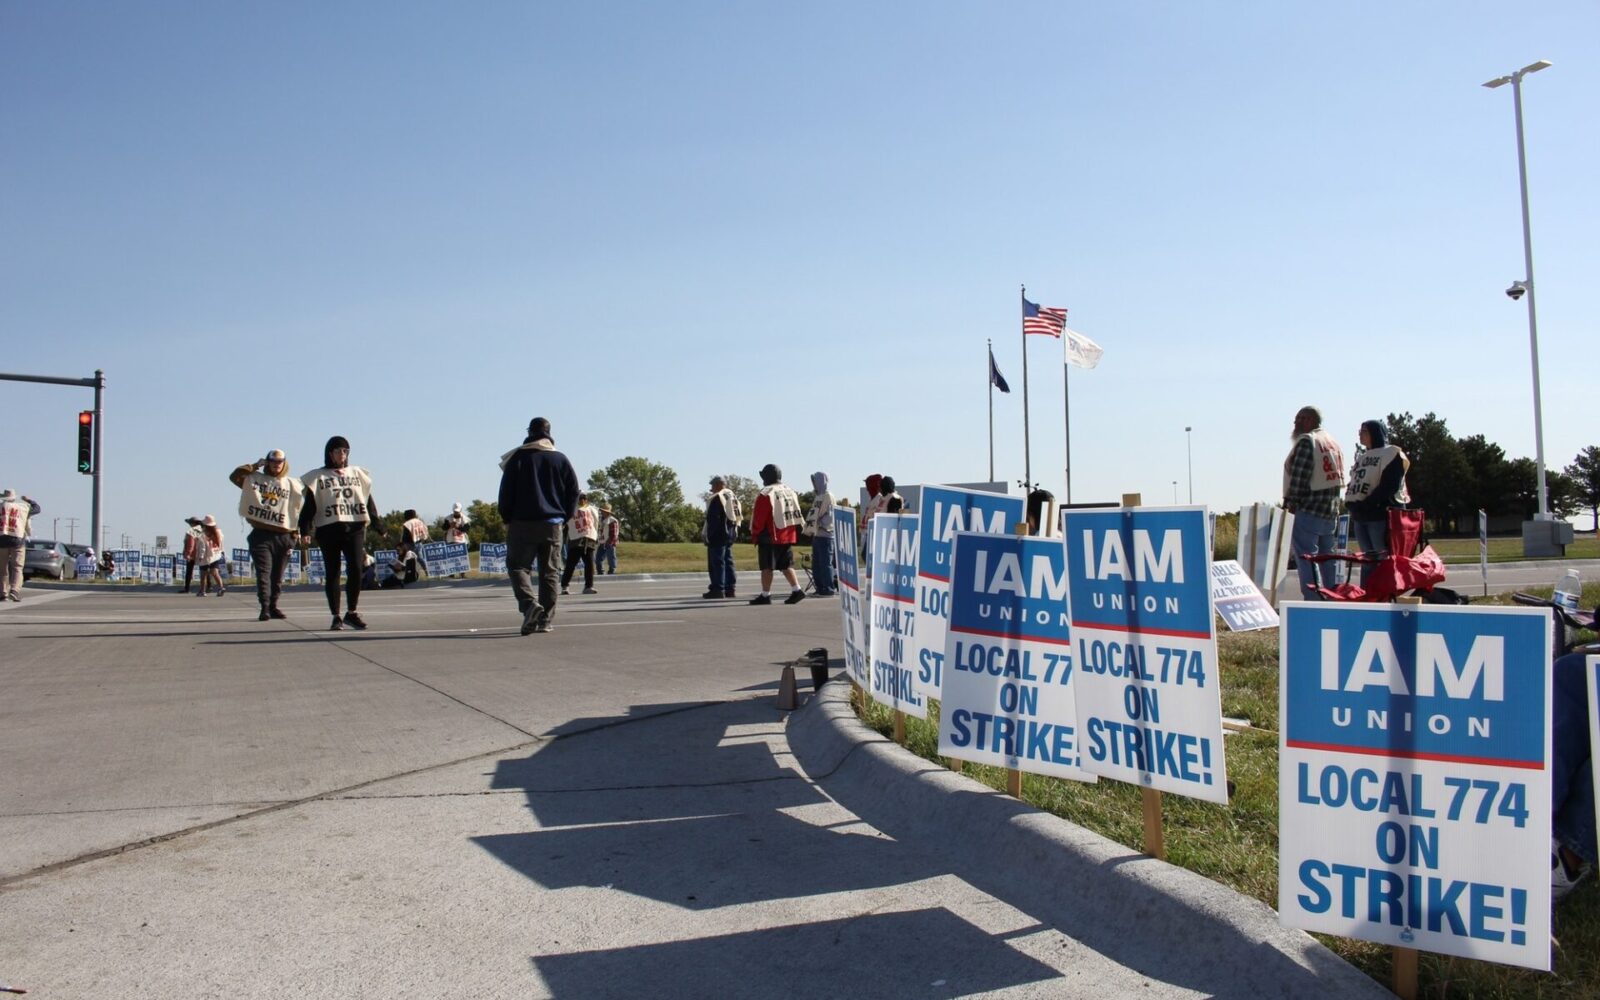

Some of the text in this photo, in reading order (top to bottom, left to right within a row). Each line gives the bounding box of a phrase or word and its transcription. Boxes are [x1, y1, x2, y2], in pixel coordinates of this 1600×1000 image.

[325, 503, 366, 517] STRIKE
[333, 488, 353, 499] 70
[248, 505, 285, 523] STRIKE
[933, 501, 1006, 543] IAM
[447, 545, 464, 553] IAM
[881, 528, 919, 567] IAM
[1083, 529, 1184, 584] IAM
[882, 572, 916, 588] UNION
[973, 550, 1067, 601] IAM
[1217, 576, 1233, 587] ON
[921, 586, 949, 619] LOC
[979, 603, 1071, 627] UNION
[1093, 592, 1179, 614] UNION
[1230, 608, 1272, 626] IAM
[875, 604, 915, 637] LOCAL 77
[890, 637, 903, 663] ON
[954, 641, 1037, 681] LOCAL
[1043, 653, 1072, 686] 77
[1079, 638, 1205, 688] LOCAL 774
[1320, 628, 1504, 701] IAM
[1000, 682, 1038, 716] ON
[1124, 684, 1159, 723] ON
[1332, 706, 1490, 738] UNION
[1087, 717, 1212, 785] STRIKE!
[1298, 762, 1529, 828] LOCAL 774
[1376, 820, 1439, 870] ON
[1297, 859, 1528, 946] STRIKE!
